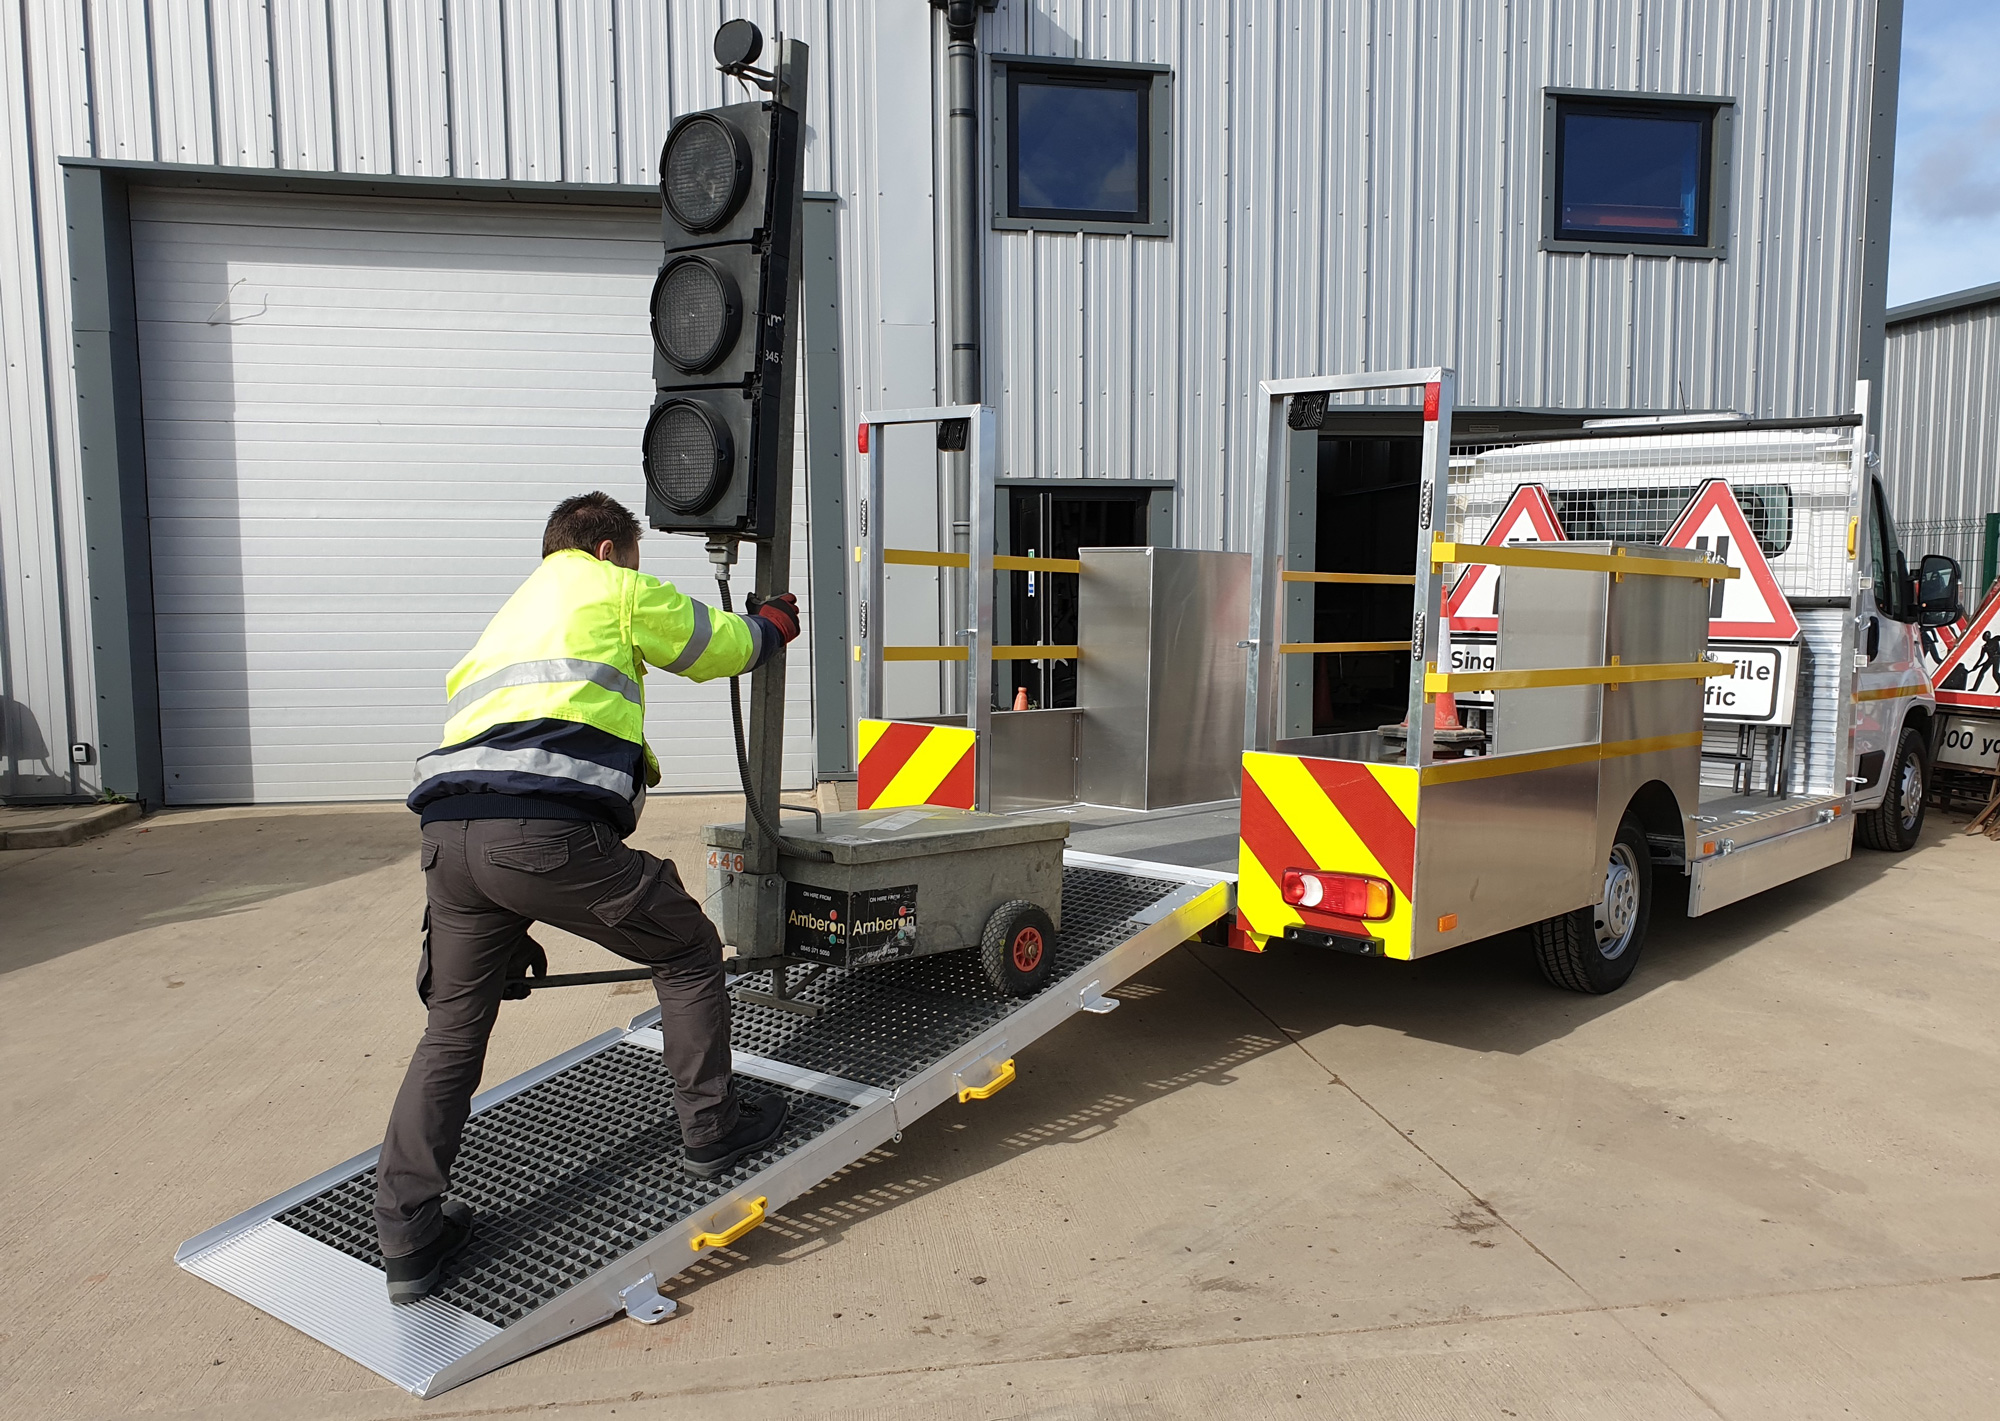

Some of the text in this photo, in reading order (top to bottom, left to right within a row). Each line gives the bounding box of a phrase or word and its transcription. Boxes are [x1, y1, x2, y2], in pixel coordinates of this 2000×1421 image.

[1452, 651, 1495, 671] Sing
[1705, 686, 1736, 706] fic
[1942, 730, 1973, 750] 00
[709, 852, 744, 872] 446
[788, 909, 846, 936] Amberon
[852, 915, 915, 937] Amberon
